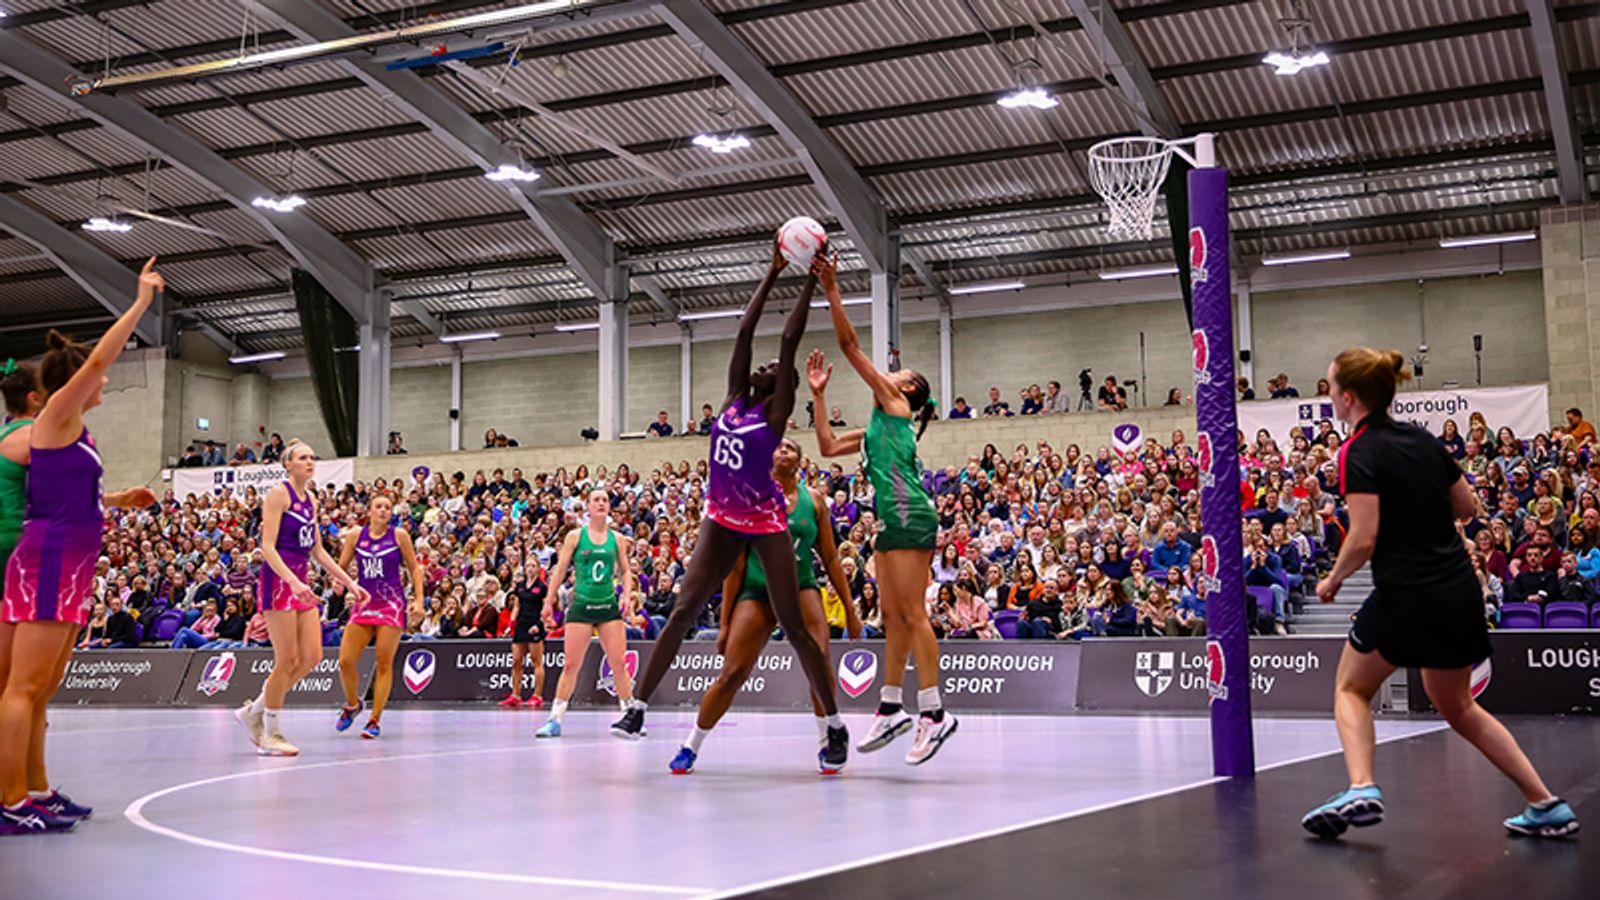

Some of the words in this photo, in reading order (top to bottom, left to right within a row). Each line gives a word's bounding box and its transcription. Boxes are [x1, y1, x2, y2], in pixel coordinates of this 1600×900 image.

[714, 435, 745, 470] GS
[362, 558, 384, 578] WA
[592, 560, 605, 582] C
[71, 660, 151, 677] Loughborough
[65, 676, 121, 691] University
[944, 677, 1005, 693] SPORT
[1179, 671, 1275, 694] Uniity
